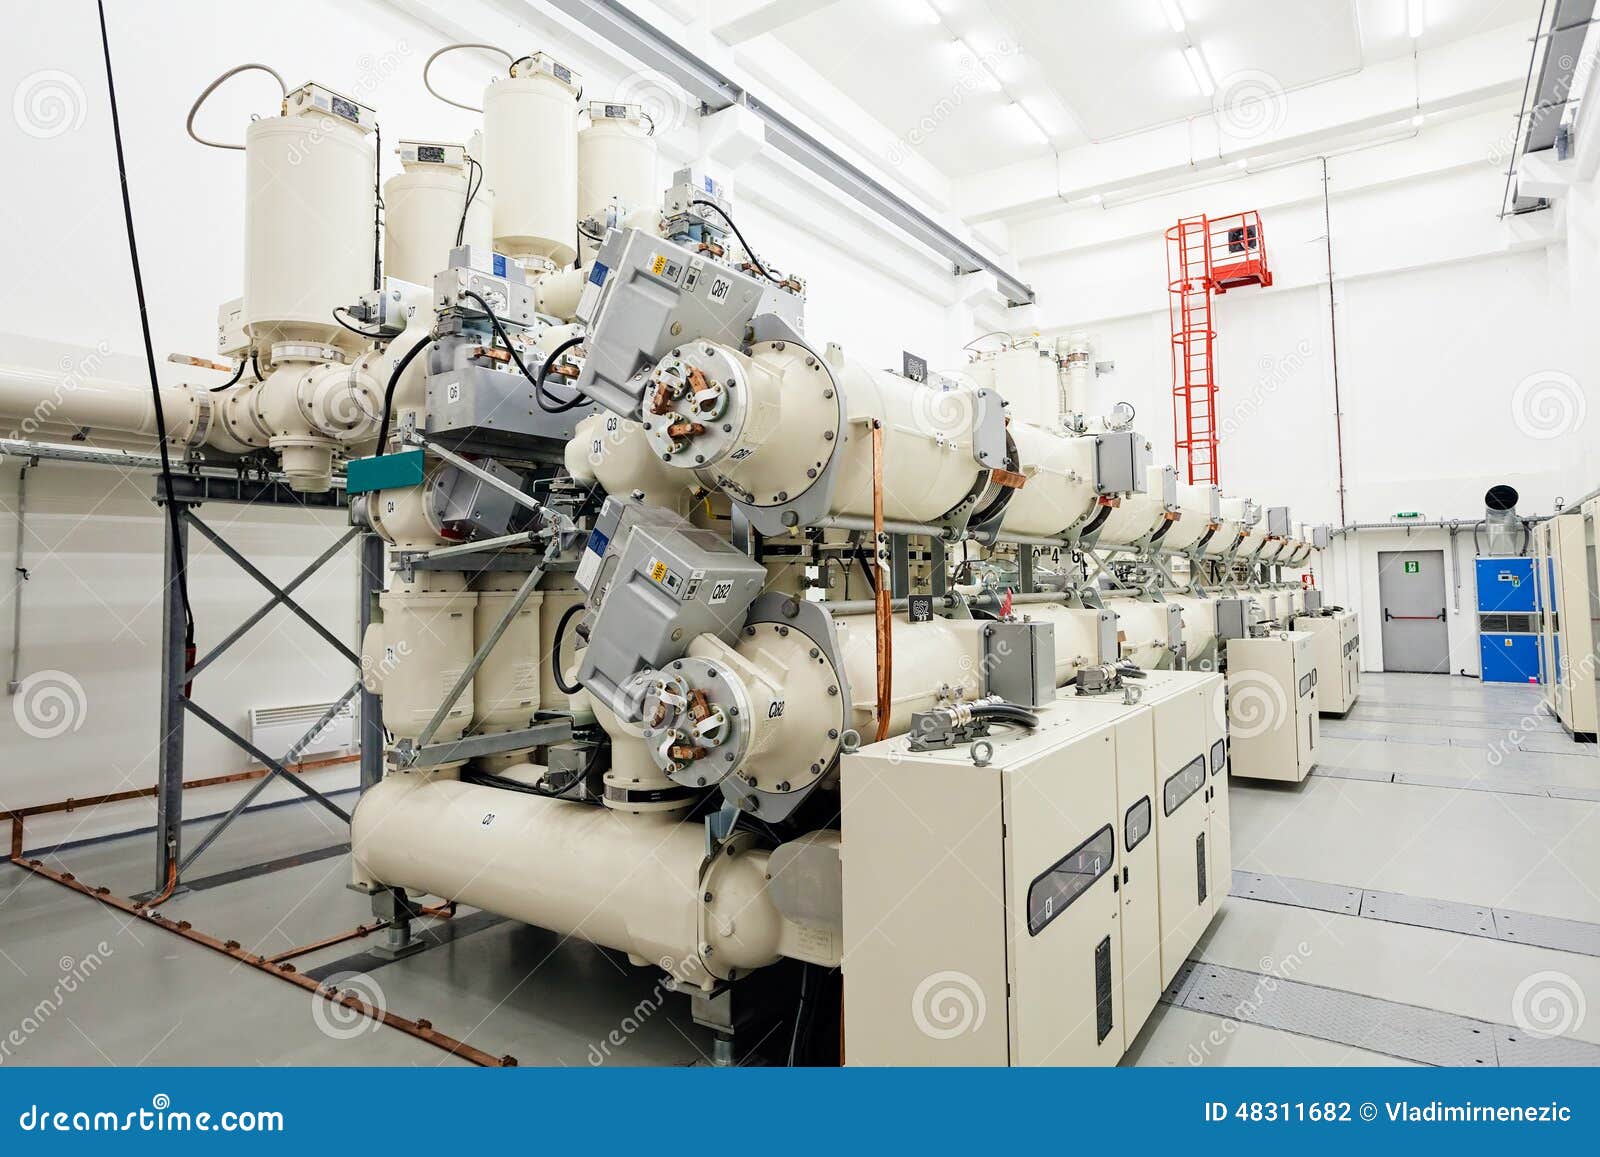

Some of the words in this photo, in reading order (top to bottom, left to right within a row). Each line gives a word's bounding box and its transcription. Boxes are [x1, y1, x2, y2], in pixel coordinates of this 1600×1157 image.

[711, 279, 729, 299] Q81
[606, 418, 617, 431] Q3
[593, 440, 602, 453] Q1
[712, 584, 731, 600] Q82
[769, 701, 785, 718] Q82
